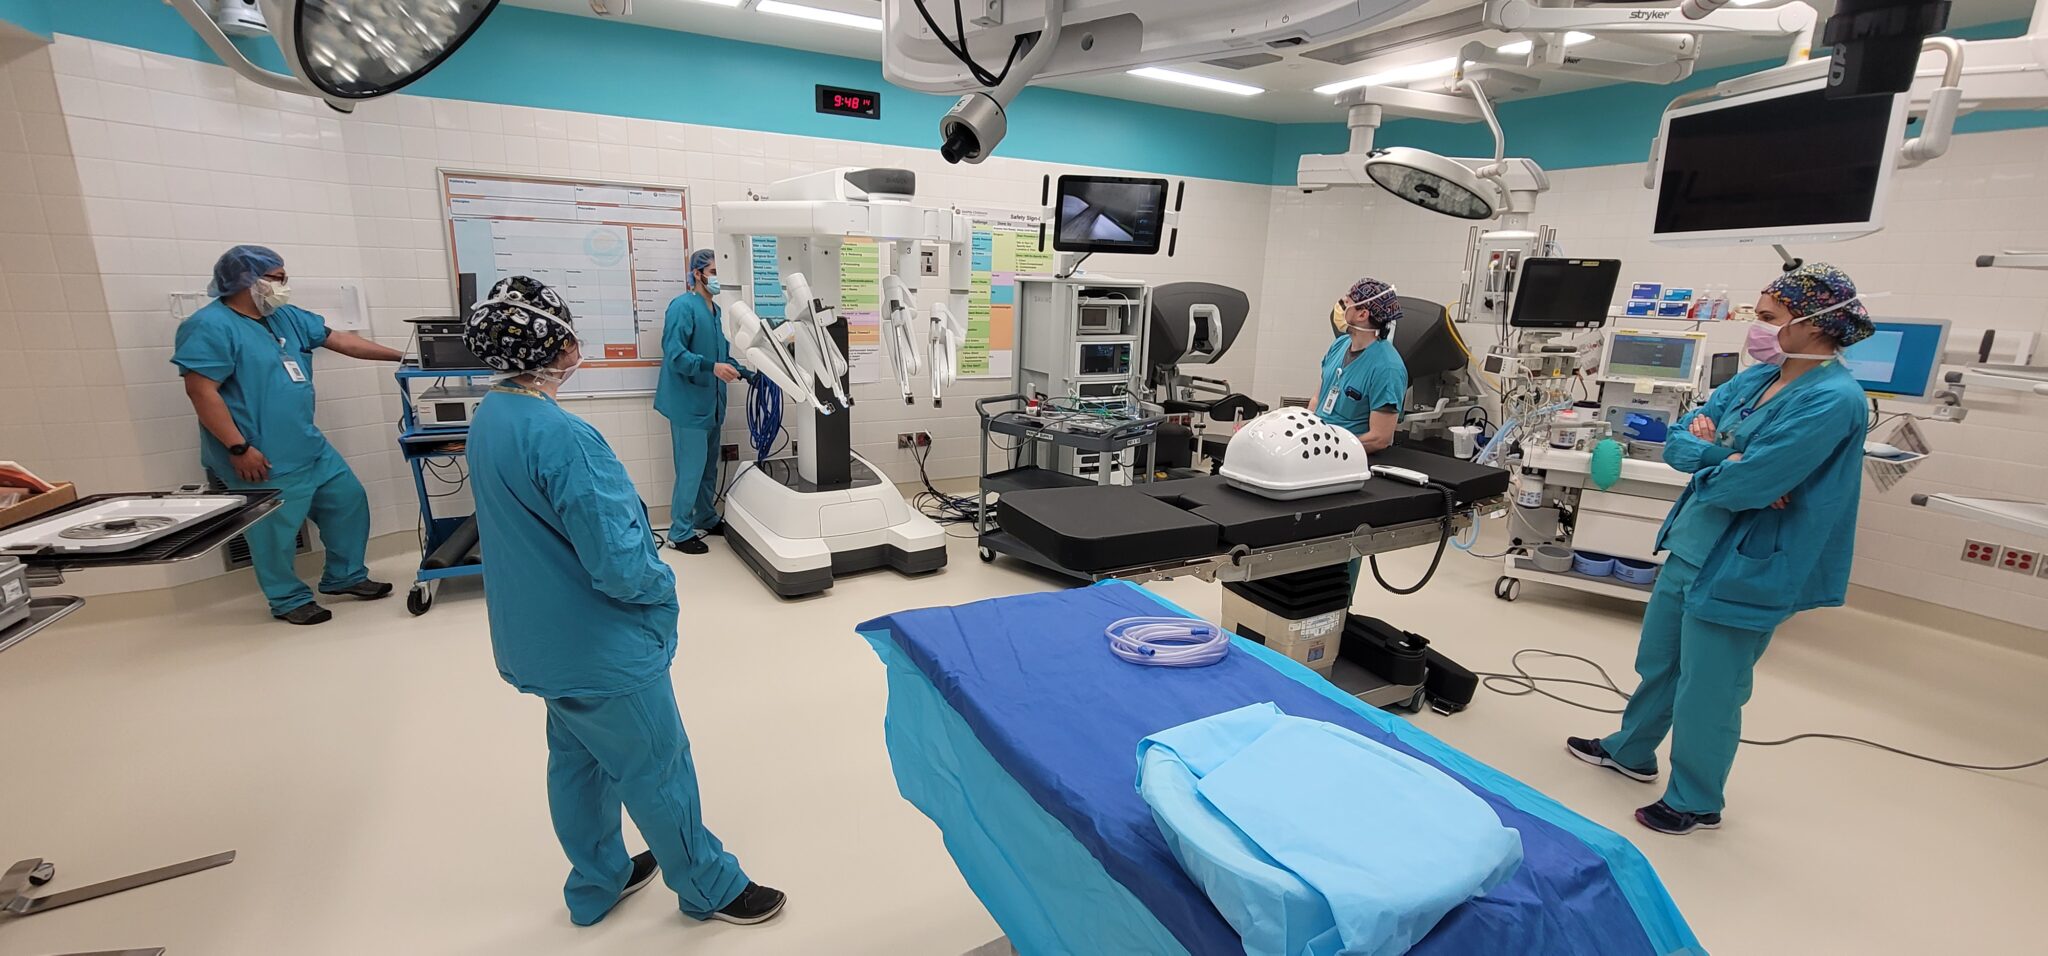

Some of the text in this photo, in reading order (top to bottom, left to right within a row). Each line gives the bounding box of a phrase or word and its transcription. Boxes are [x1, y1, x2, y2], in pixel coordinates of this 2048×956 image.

[1629, 9, 1670, 21] stryker
[834, 95, 860, 109] 9:48
[906, 247, 911, 255] 3
